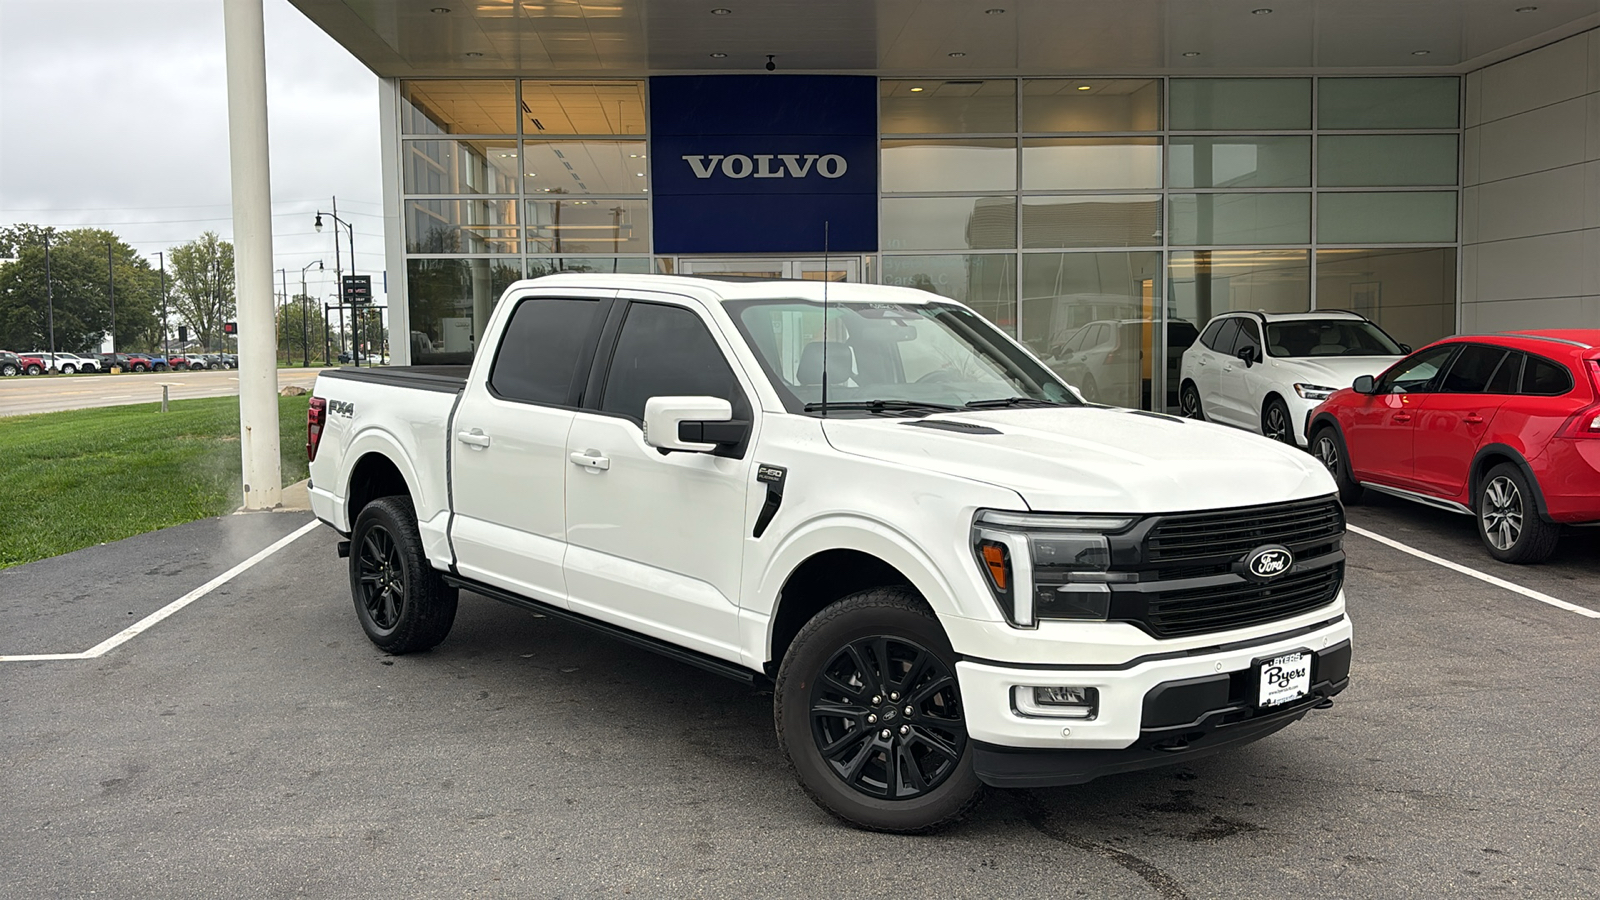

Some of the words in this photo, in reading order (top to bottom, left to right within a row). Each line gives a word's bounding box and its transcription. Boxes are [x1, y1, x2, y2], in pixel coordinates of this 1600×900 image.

[682, 154, 848, 179] VOLVO
[884, 274, 916, 285] Cars
[921, 273, 948, 285] LLC
[328, 399, 354, 416] FX4
[1258, 553, 1285, 573] Ford
[1274, 652, 1301, 666] BYERS
[1264, 666, 1306, 688] Byers
